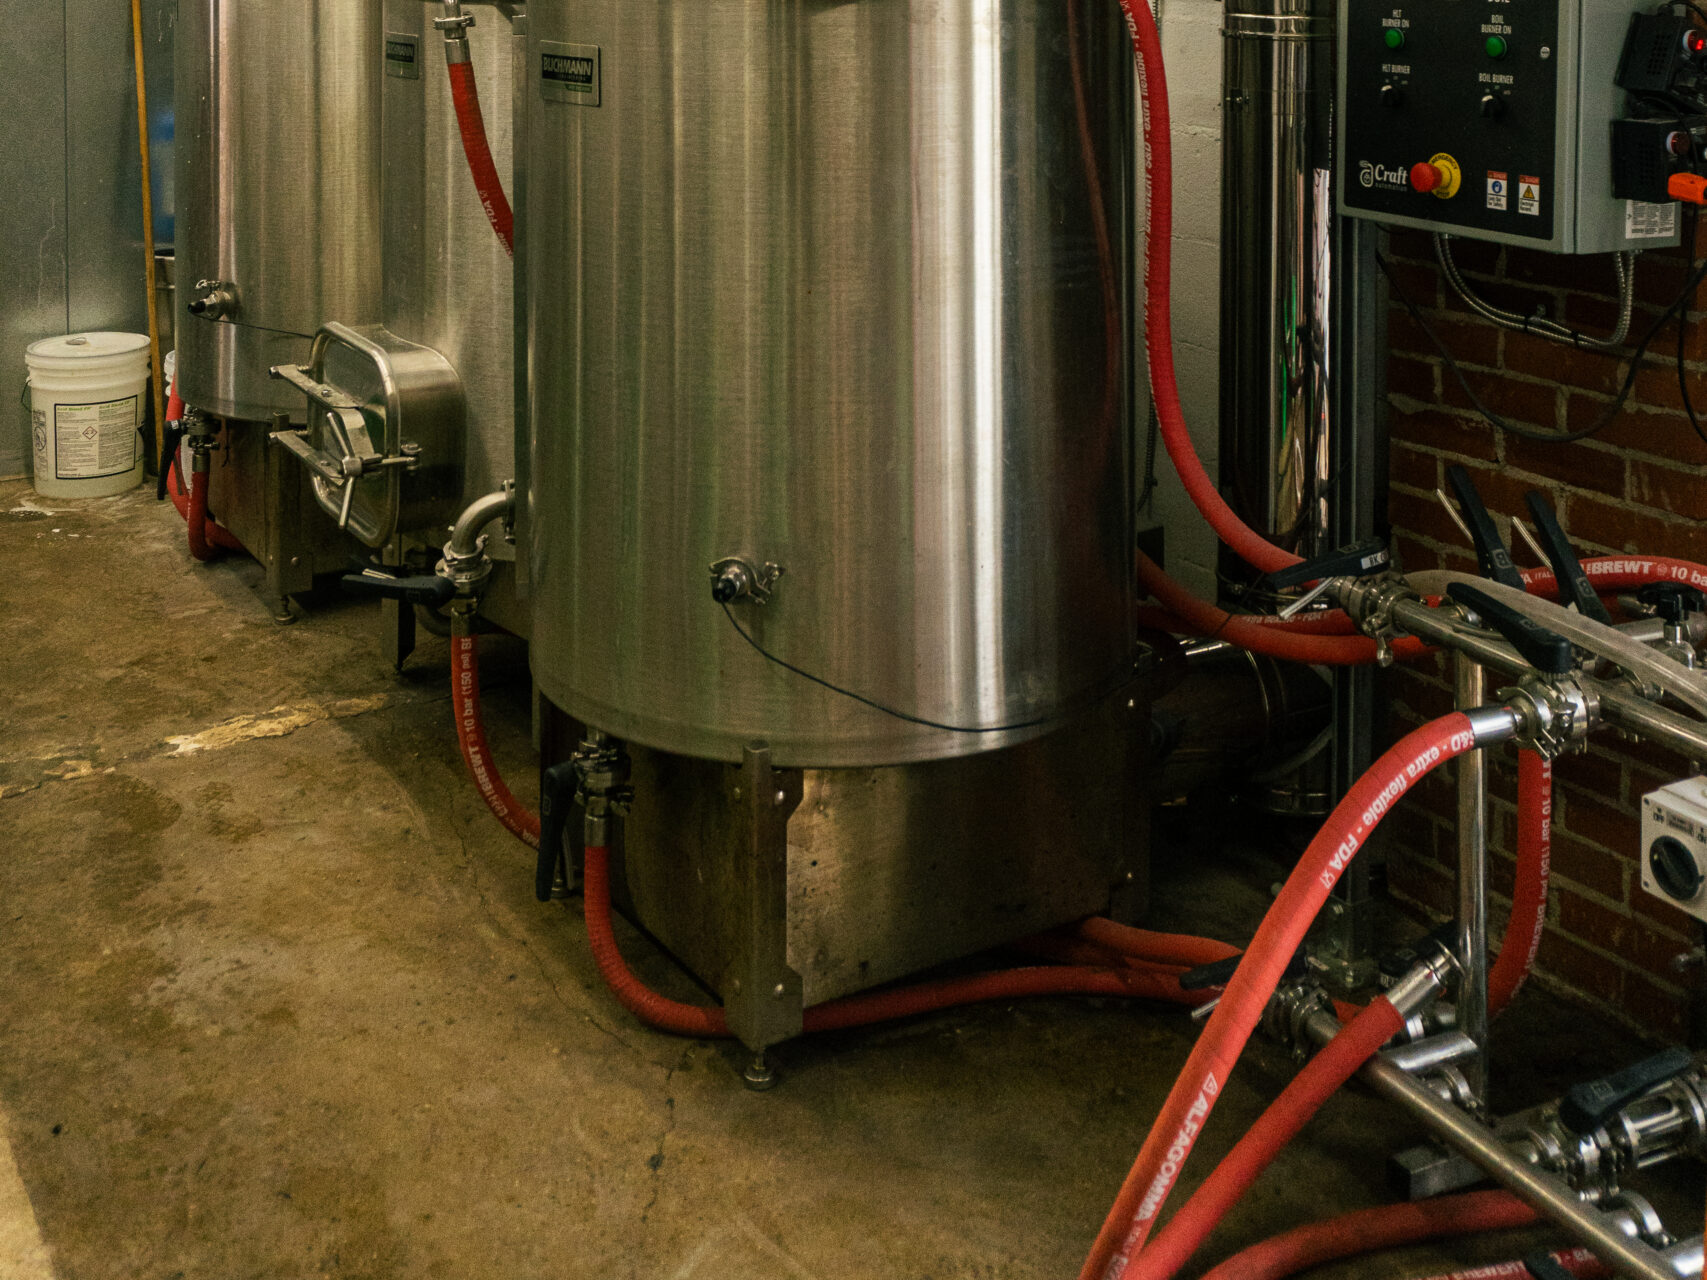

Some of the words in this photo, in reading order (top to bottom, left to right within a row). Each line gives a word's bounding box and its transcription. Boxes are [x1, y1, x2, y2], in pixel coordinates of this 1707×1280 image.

[1382, 18, 1401, 28] BURNER
[1402, 19, 1410, 28] ON
[1491, 14, 1504, 24] BOIL
[1481, 24, 1502, 34] BURNER
[1503, 25, 1512, 35] ON
[1391, 64, 1411, 74] BURNER
[1479, 73, 1491, 83] BOIL
[1493, 74, 1514, 84] BURNER
[1431, 154, 1459, 170] MERGENCY
[1375, 163, 1408, 185] Craft
[1535, 571, 1553, 580] ITAL
[1671, 566, 1688, 580] 10
[1691, 570, 1707, 587] ba
[461, 672, 473, 696] (150
[463, 698, 474, 716] bar
[464, 719, 476, 732] 10
[1406, 747, 1440, 778] extra
[1362, 773, 1408, 826] flexible
[1542, 799, 1551, 815] 10
[1329, 834, 1359, 871] FDA
[1133, 1091, 1209, 1221] ALFAGOMMA
